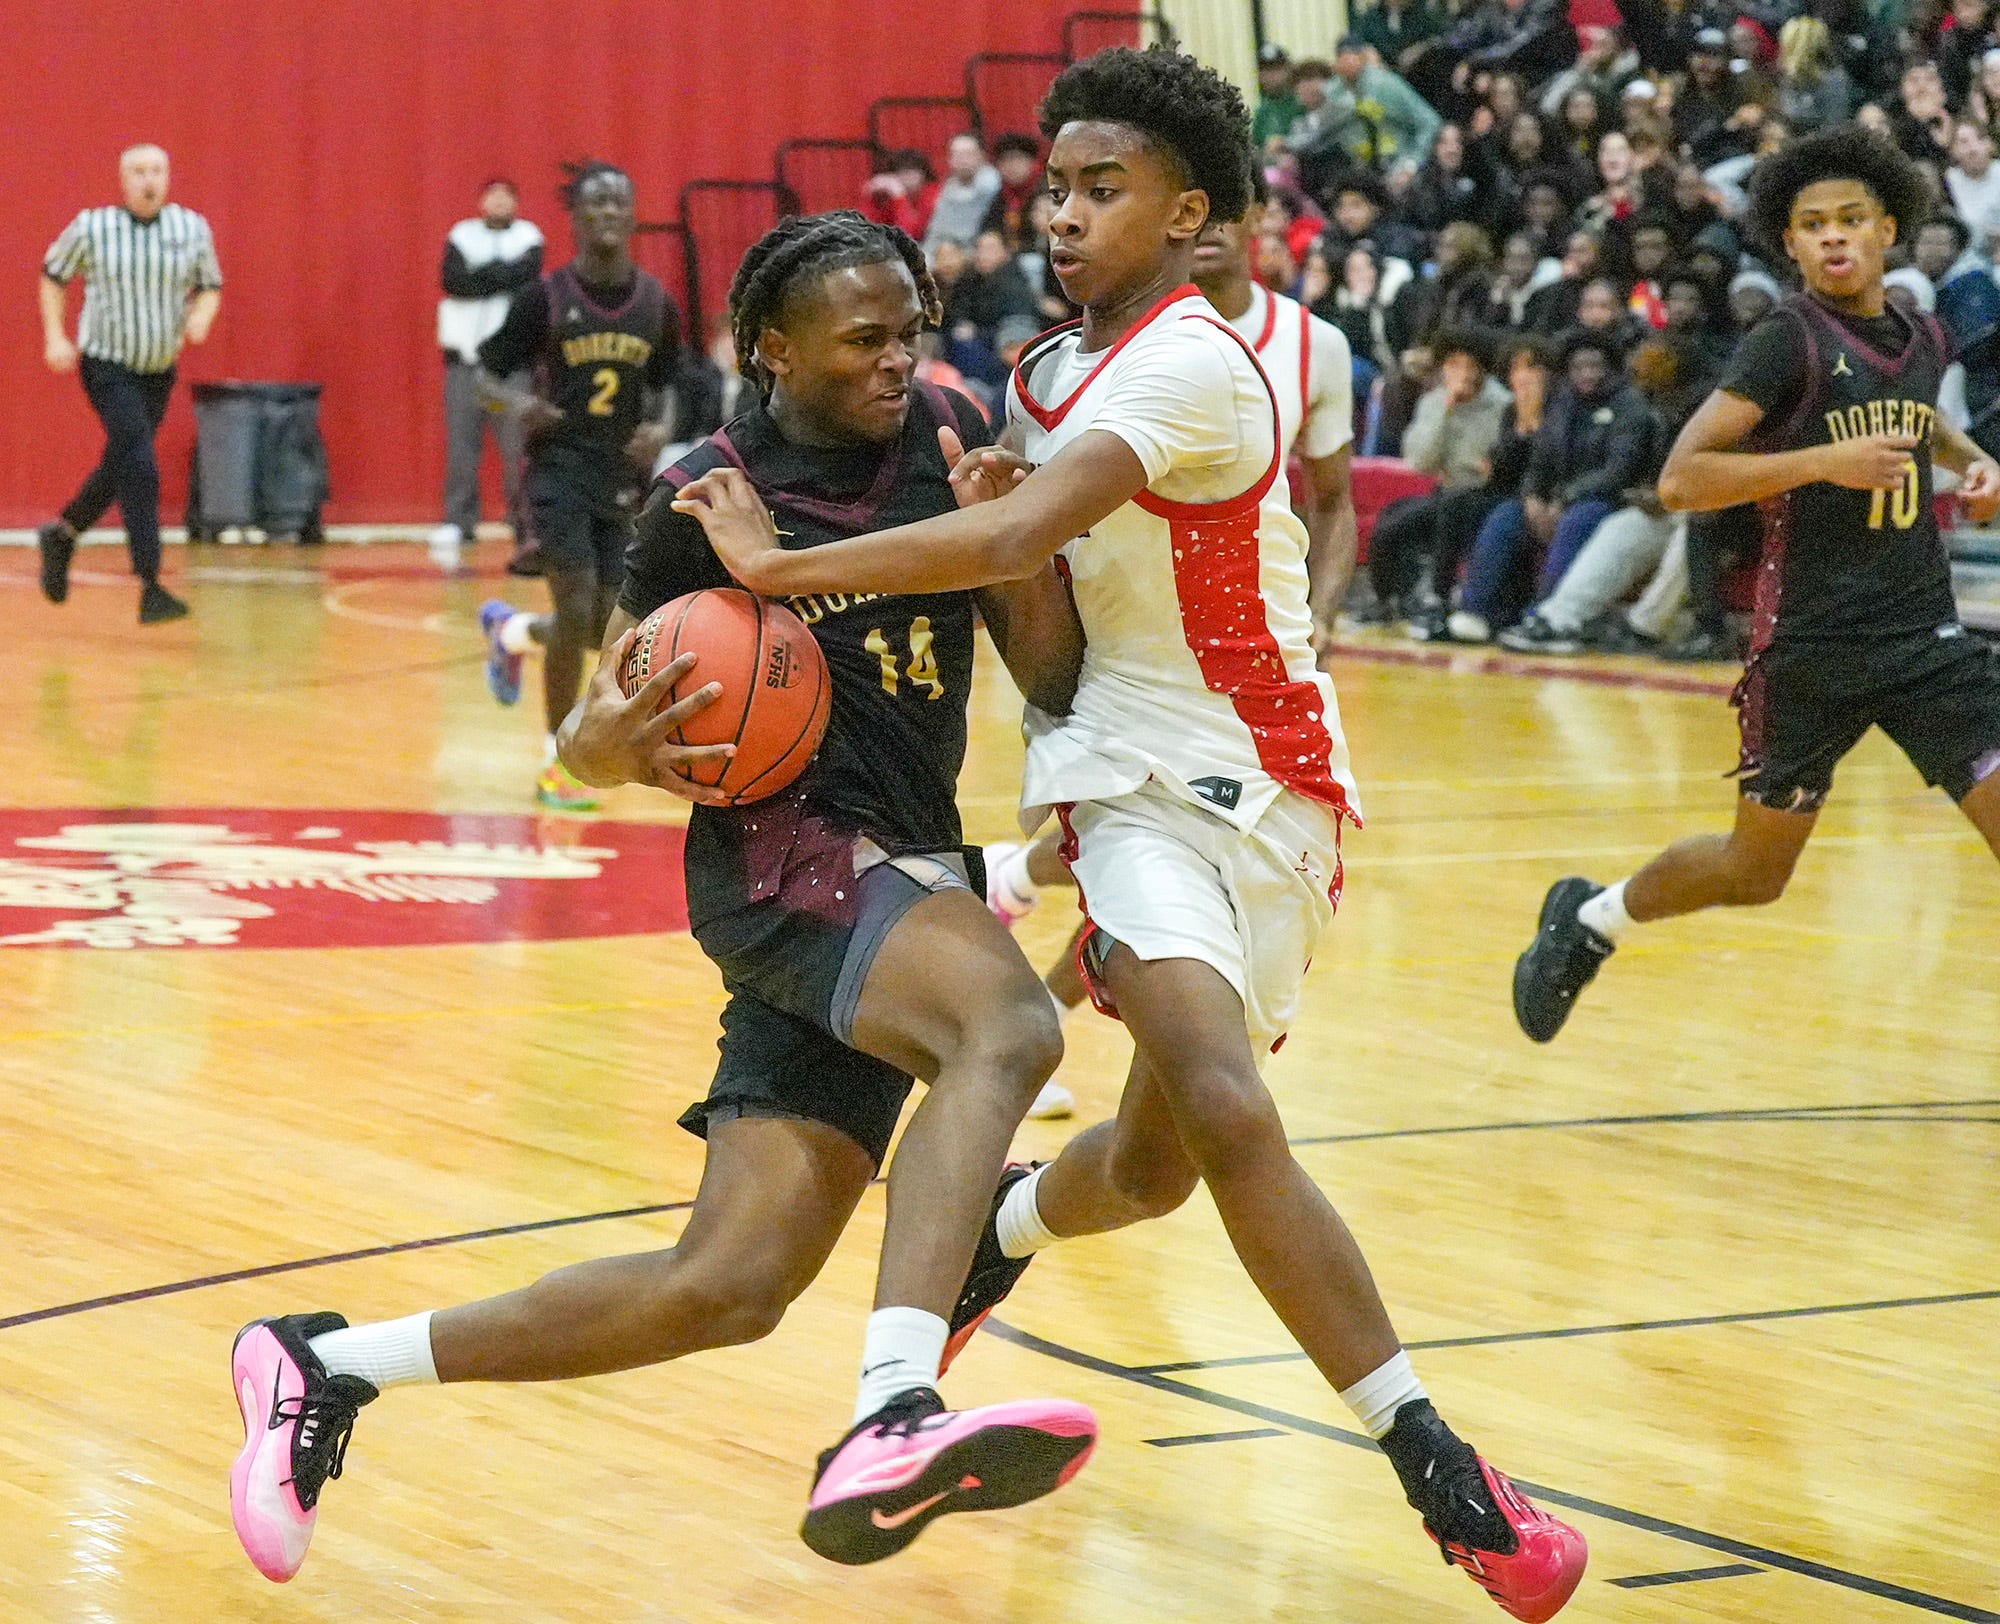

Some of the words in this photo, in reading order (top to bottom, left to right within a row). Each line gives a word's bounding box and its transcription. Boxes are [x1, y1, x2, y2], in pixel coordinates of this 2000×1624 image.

[587, 368, 619, 416] 2
[1825, 399, 1935, 440] DOHERT
[1867, 460, 1919, 529] 10
[766, 645, 784, 688] NFHS
[864, 615, 945, 700] 14
[1221, 786, 1234, 799] M
